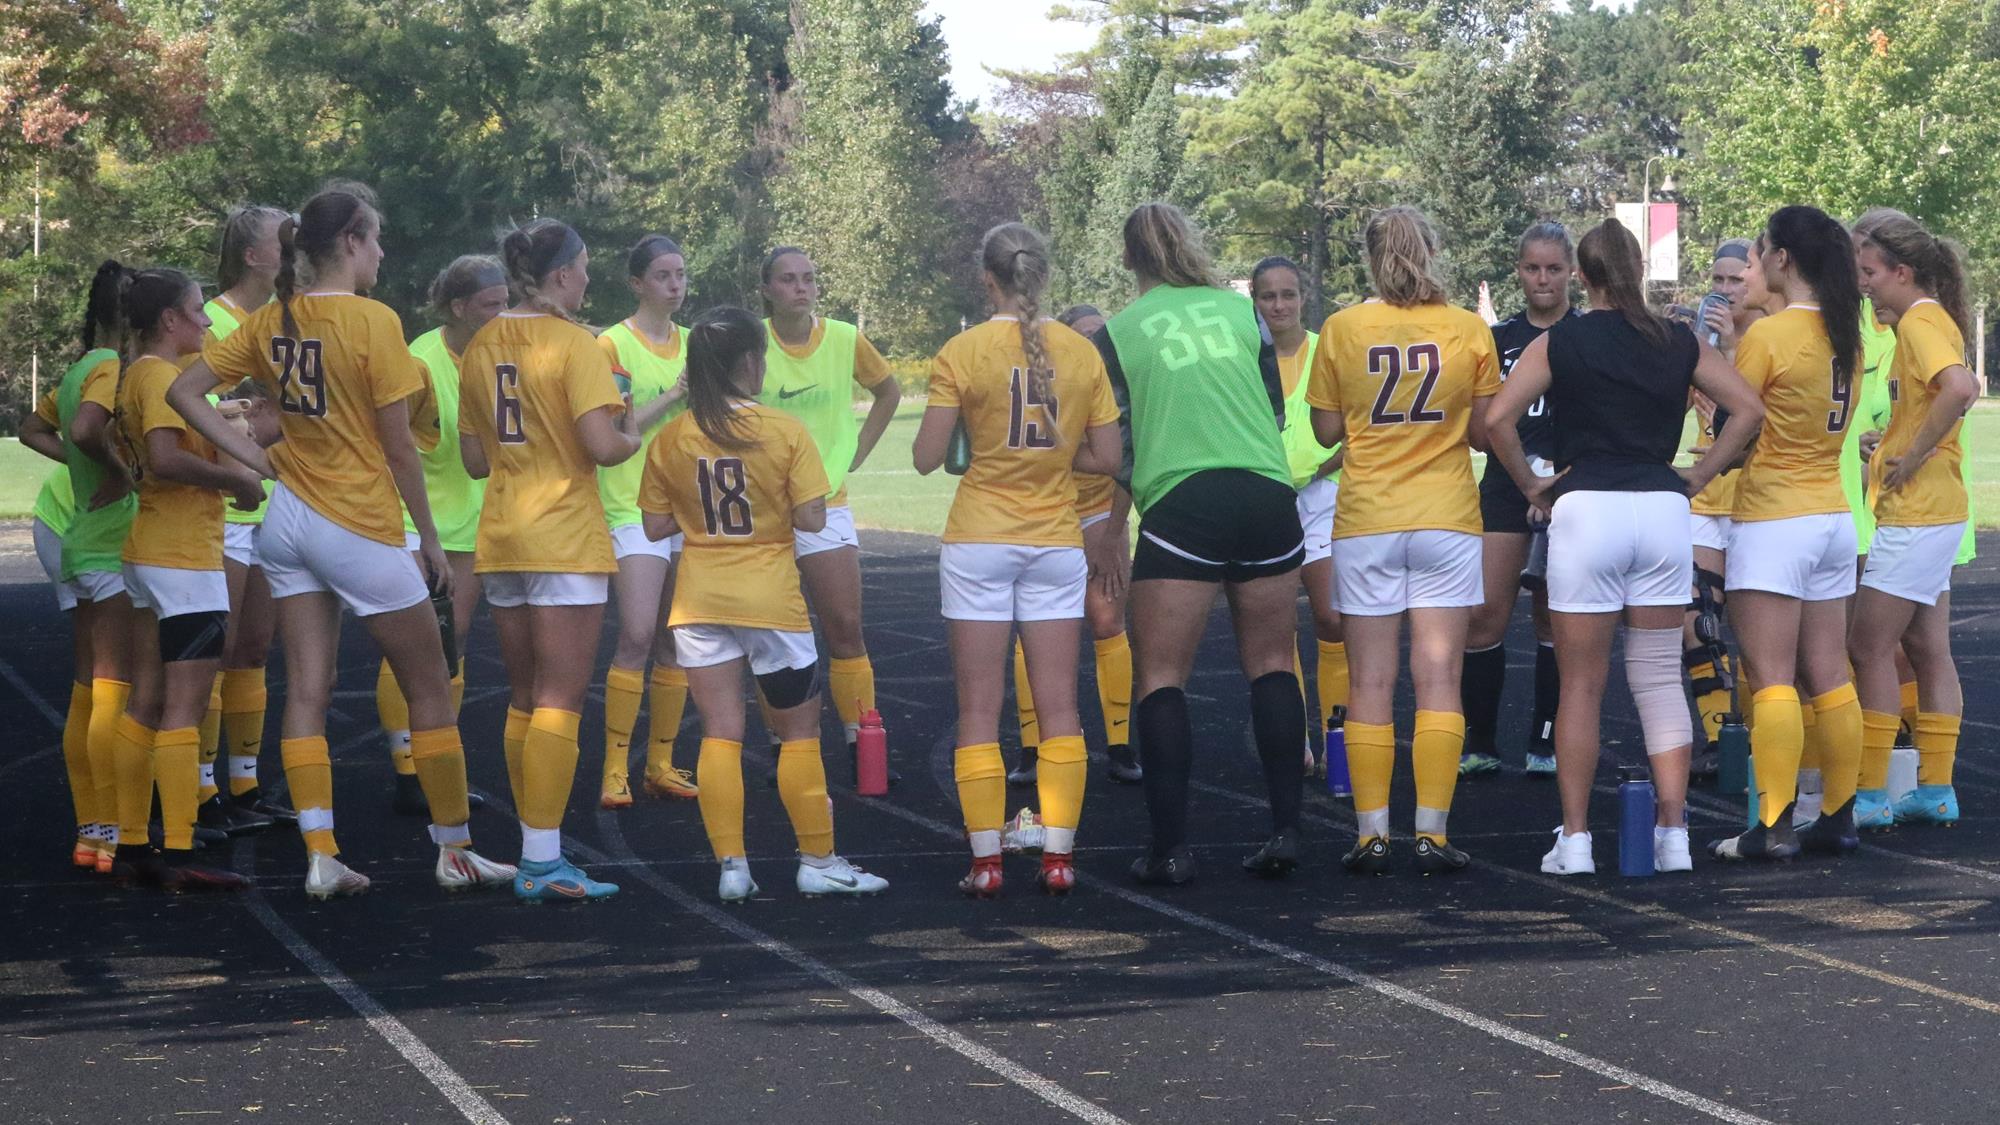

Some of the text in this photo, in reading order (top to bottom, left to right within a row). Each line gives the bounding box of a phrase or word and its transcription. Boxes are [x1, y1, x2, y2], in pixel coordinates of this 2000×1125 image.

[1140, 300, 1239, 371] 35
[272, 336, 327, 417] 29
[495, 363, 527, 445] 6
[1007, 366, 1059, 449] 15
[1368, 342, 1444, 425] 22
[1826, 355, 1853, 433] 9
[696, 456, 754, 537] 18
